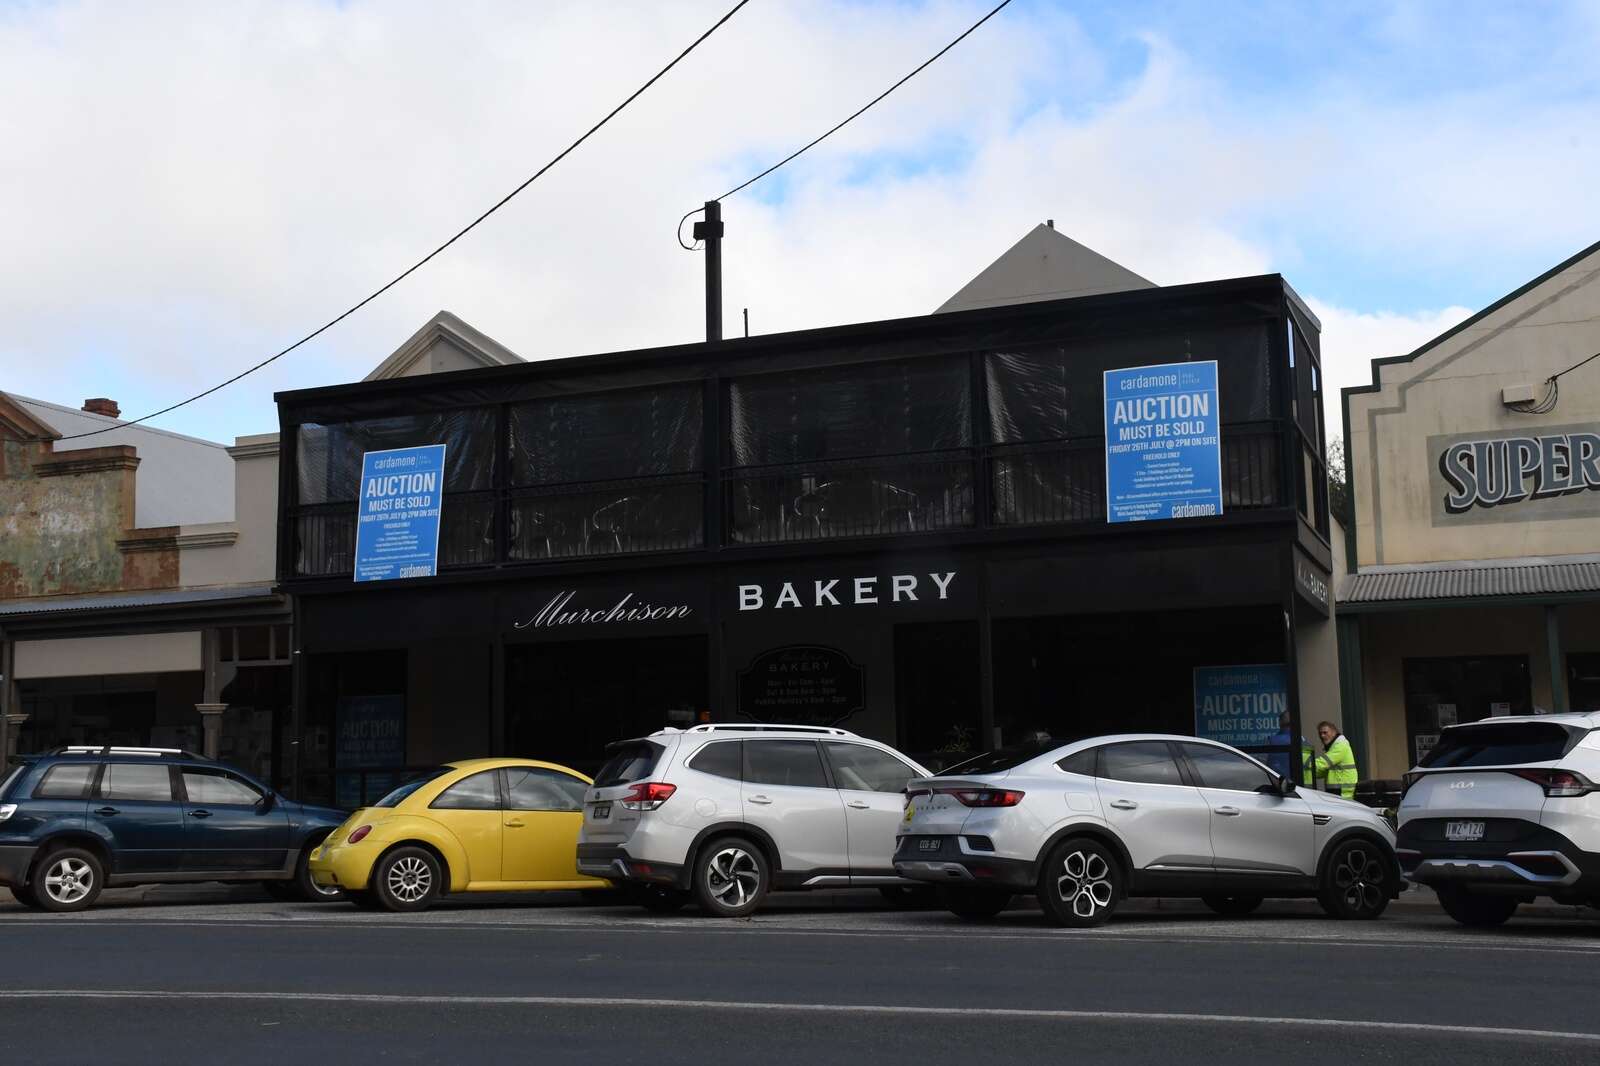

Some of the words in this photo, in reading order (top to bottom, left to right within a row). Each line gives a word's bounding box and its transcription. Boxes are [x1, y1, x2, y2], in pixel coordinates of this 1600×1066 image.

[1120, 374, 1177, 390] cardamone
[1113, 393, 1209, 425] AUCTION
[1119, 425, 1153, 441] MUST
[1155, 424, 1170, 437] BE
[1172, 420, 1205, 436] SOLD
[1109, 443, 1131, 454] FRIDAY
[1149, 441, 1165, 450] JULY
[1165, 440, 1175, 450] @
[1175, 438, 1191, 448] 2PM
[1191, 438, 1201, 446] ON
[1202, 436, 1217, 446] SITE
[374, 456, 416, 470] cardamone
[1438, 433, 1600, 514] SUPER
[365, 472, 436, 498] AUCTION
[368, 498, 394, 512] MUST
[394, 497, 407, 510] BE
[407, 495, 431, 508] SOLD
[1171, 501, 1216, 519] cardamone
[399, 564, 432, 579] cardamone
[738, 571, 957, 611] BAKERY
[513, 590, 693, 629] Murchison
[767, 660, 831, 672] BAKERY
[1202, 692, 1287, 716] AUCTION
[1207, 718, 1238, 731] MUST
[1240, 718, 1254, 730] BE
